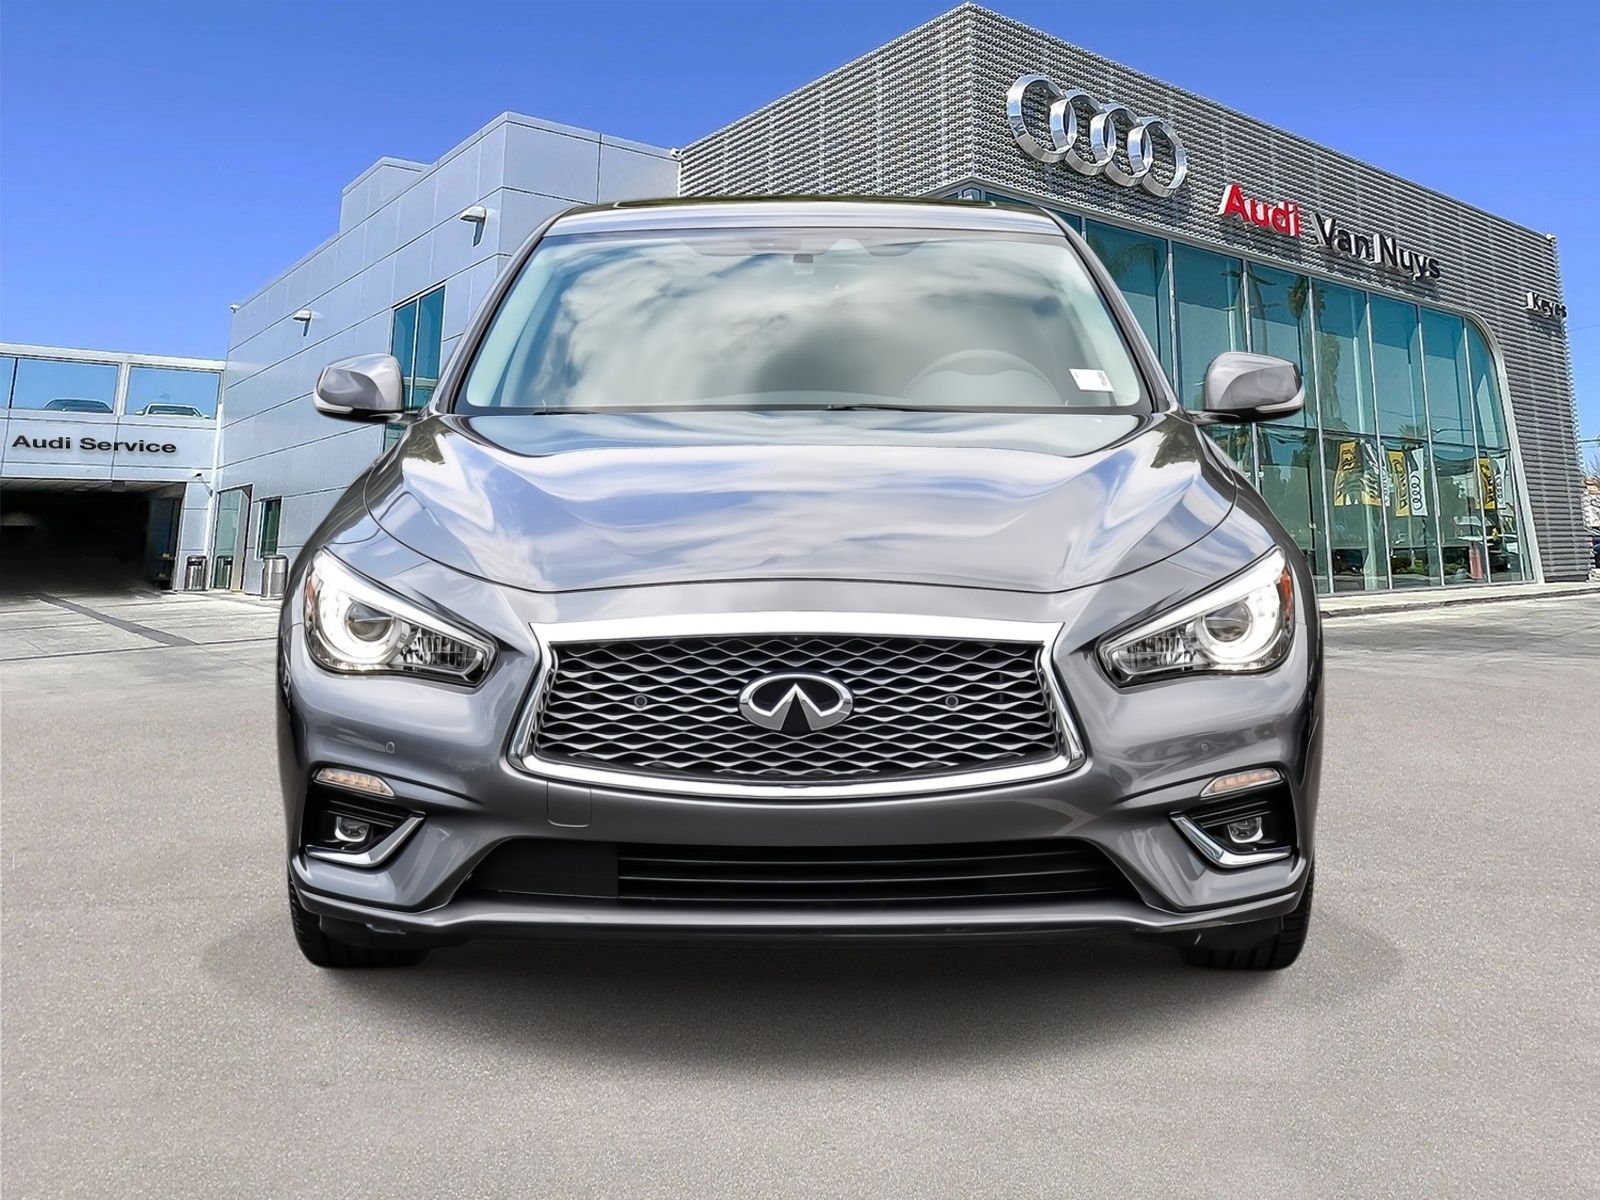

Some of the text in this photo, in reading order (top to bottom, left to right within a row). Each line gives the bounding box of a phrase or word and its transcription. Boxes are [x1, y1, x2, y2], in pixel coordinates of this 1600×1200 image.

[1218, 183, 1440, 280] Audi Van Nuys
[1527, 292, 1568, 318] Keyes
[12, 435, 177, 454] Audi Service
